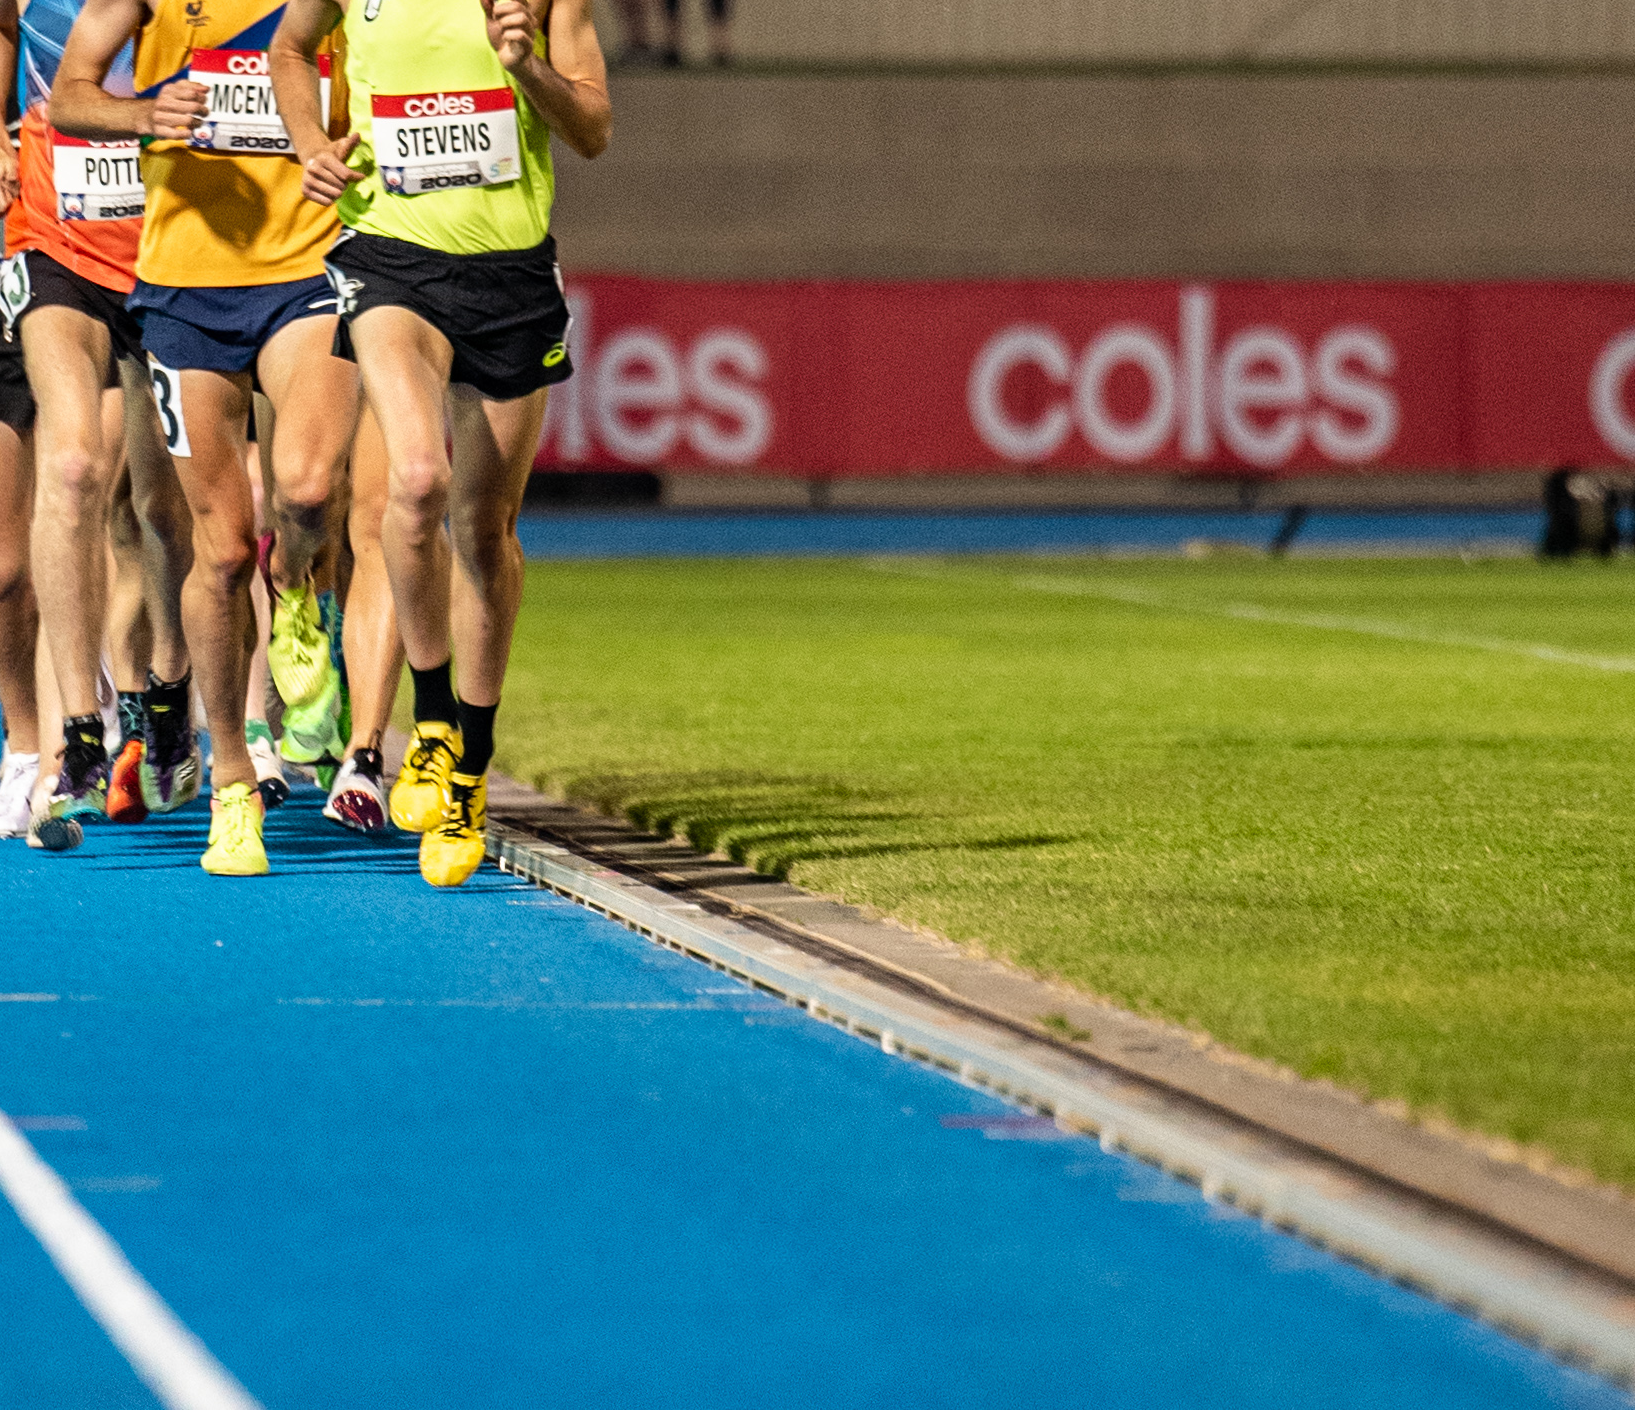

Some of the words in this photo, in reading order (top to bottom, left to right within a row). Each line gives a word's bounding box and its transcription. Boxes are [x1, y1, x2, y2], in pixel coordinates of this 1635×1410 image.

[227, 52, 270, 75] col
[212, 84, 279, 115] MCEN
[403, 93, 476, 117] coles
[231, 136, 289, 149] 2020
[397, 123, 491, 157] STEVENS
[421, 173, 481, 189] 2020
[99, 204, 145, 218] 202
[546, 290, 770, 465] les
[969, 283, 1400, 465] coles
